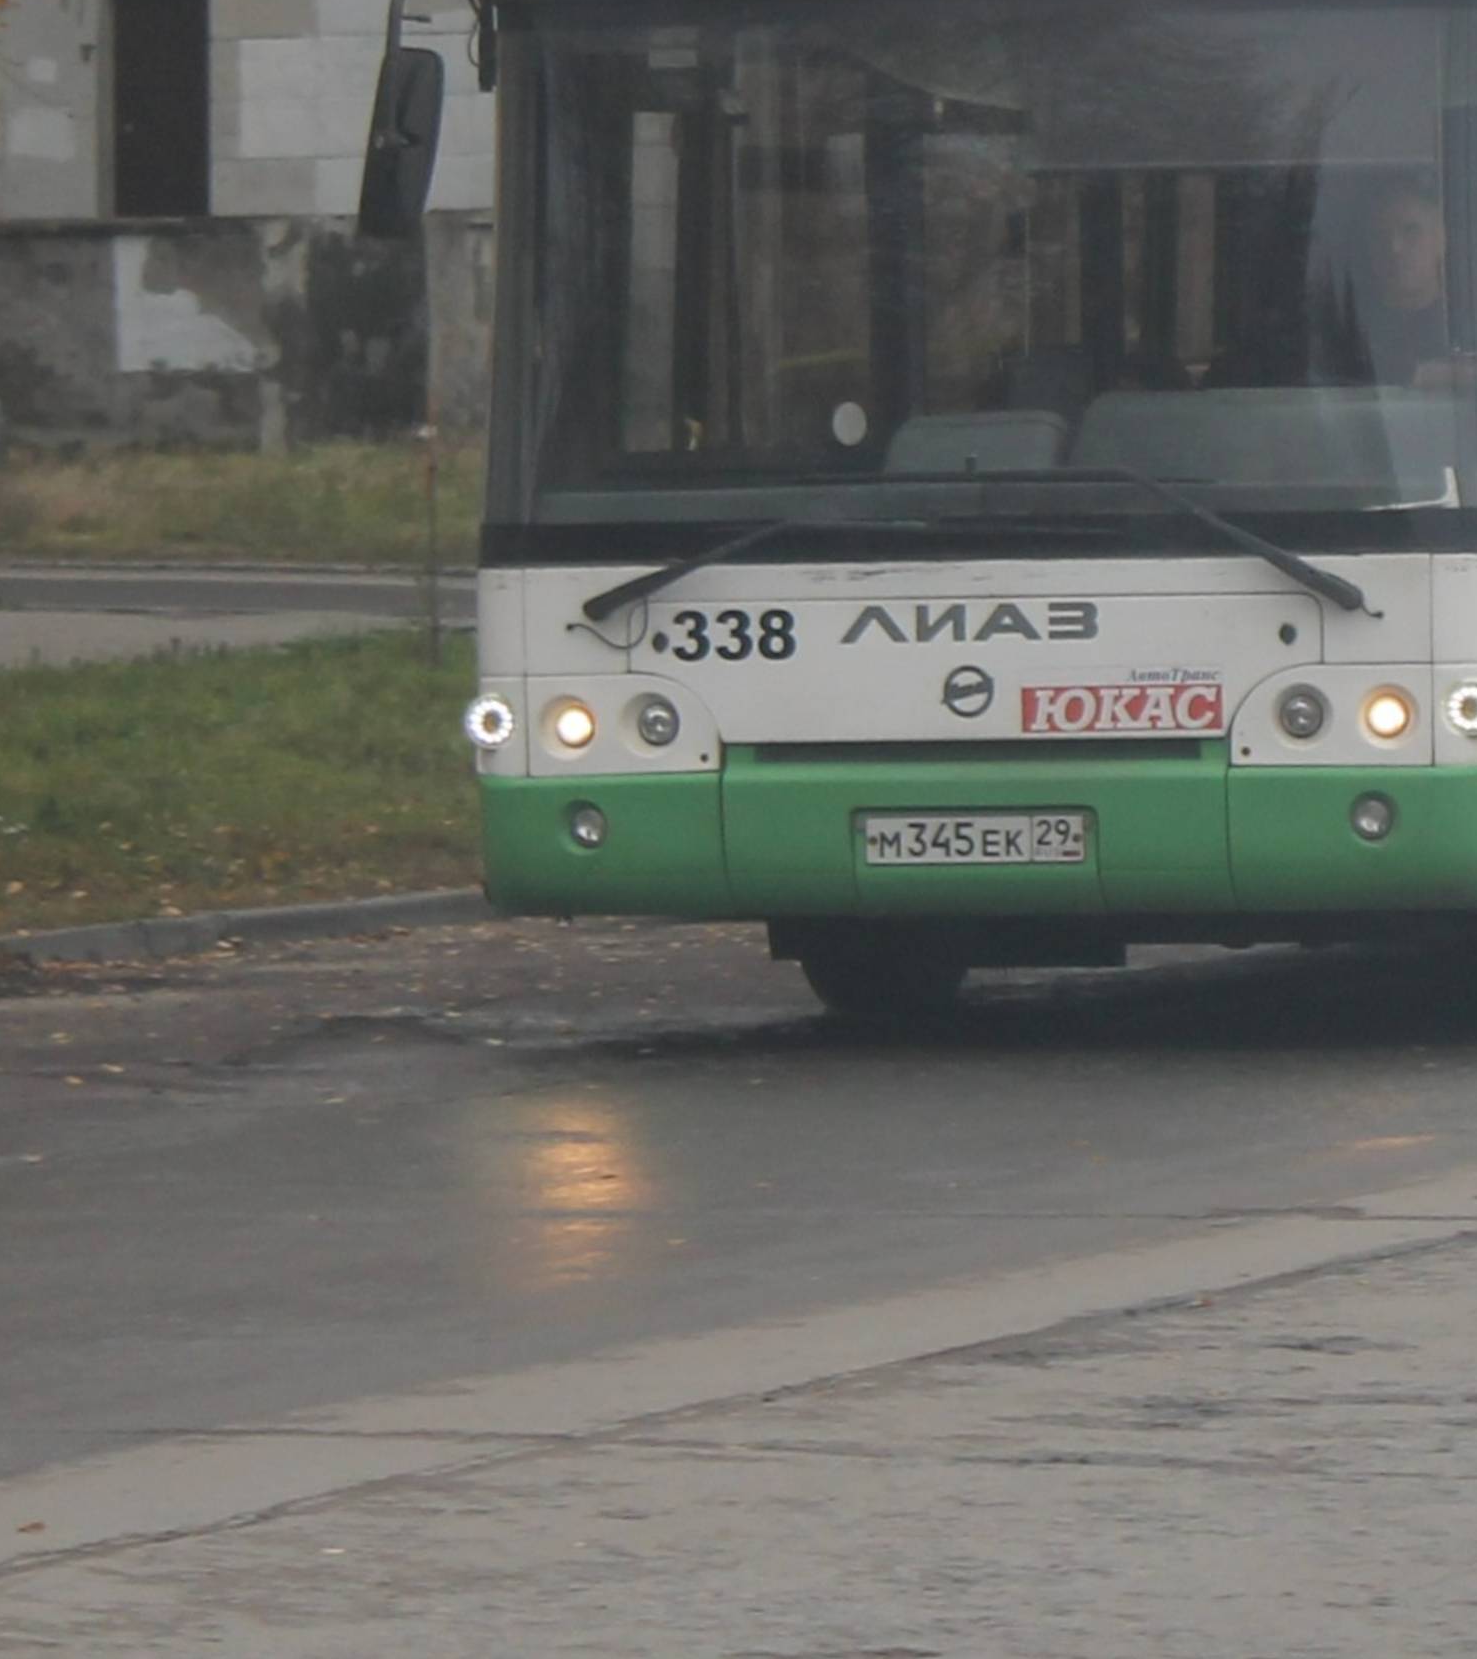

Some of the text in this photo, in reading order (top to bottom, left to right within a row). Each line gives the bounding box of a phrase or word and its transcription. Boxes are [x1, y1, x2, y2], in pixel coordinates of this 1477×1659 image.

[672, 609, 797, 662] 338
[839, 602, 1100, 644] ЛИАЗ
[1029, 686, 1218, 732] ЮКАС
[878, 821, 1024, 857] М345ЕК
